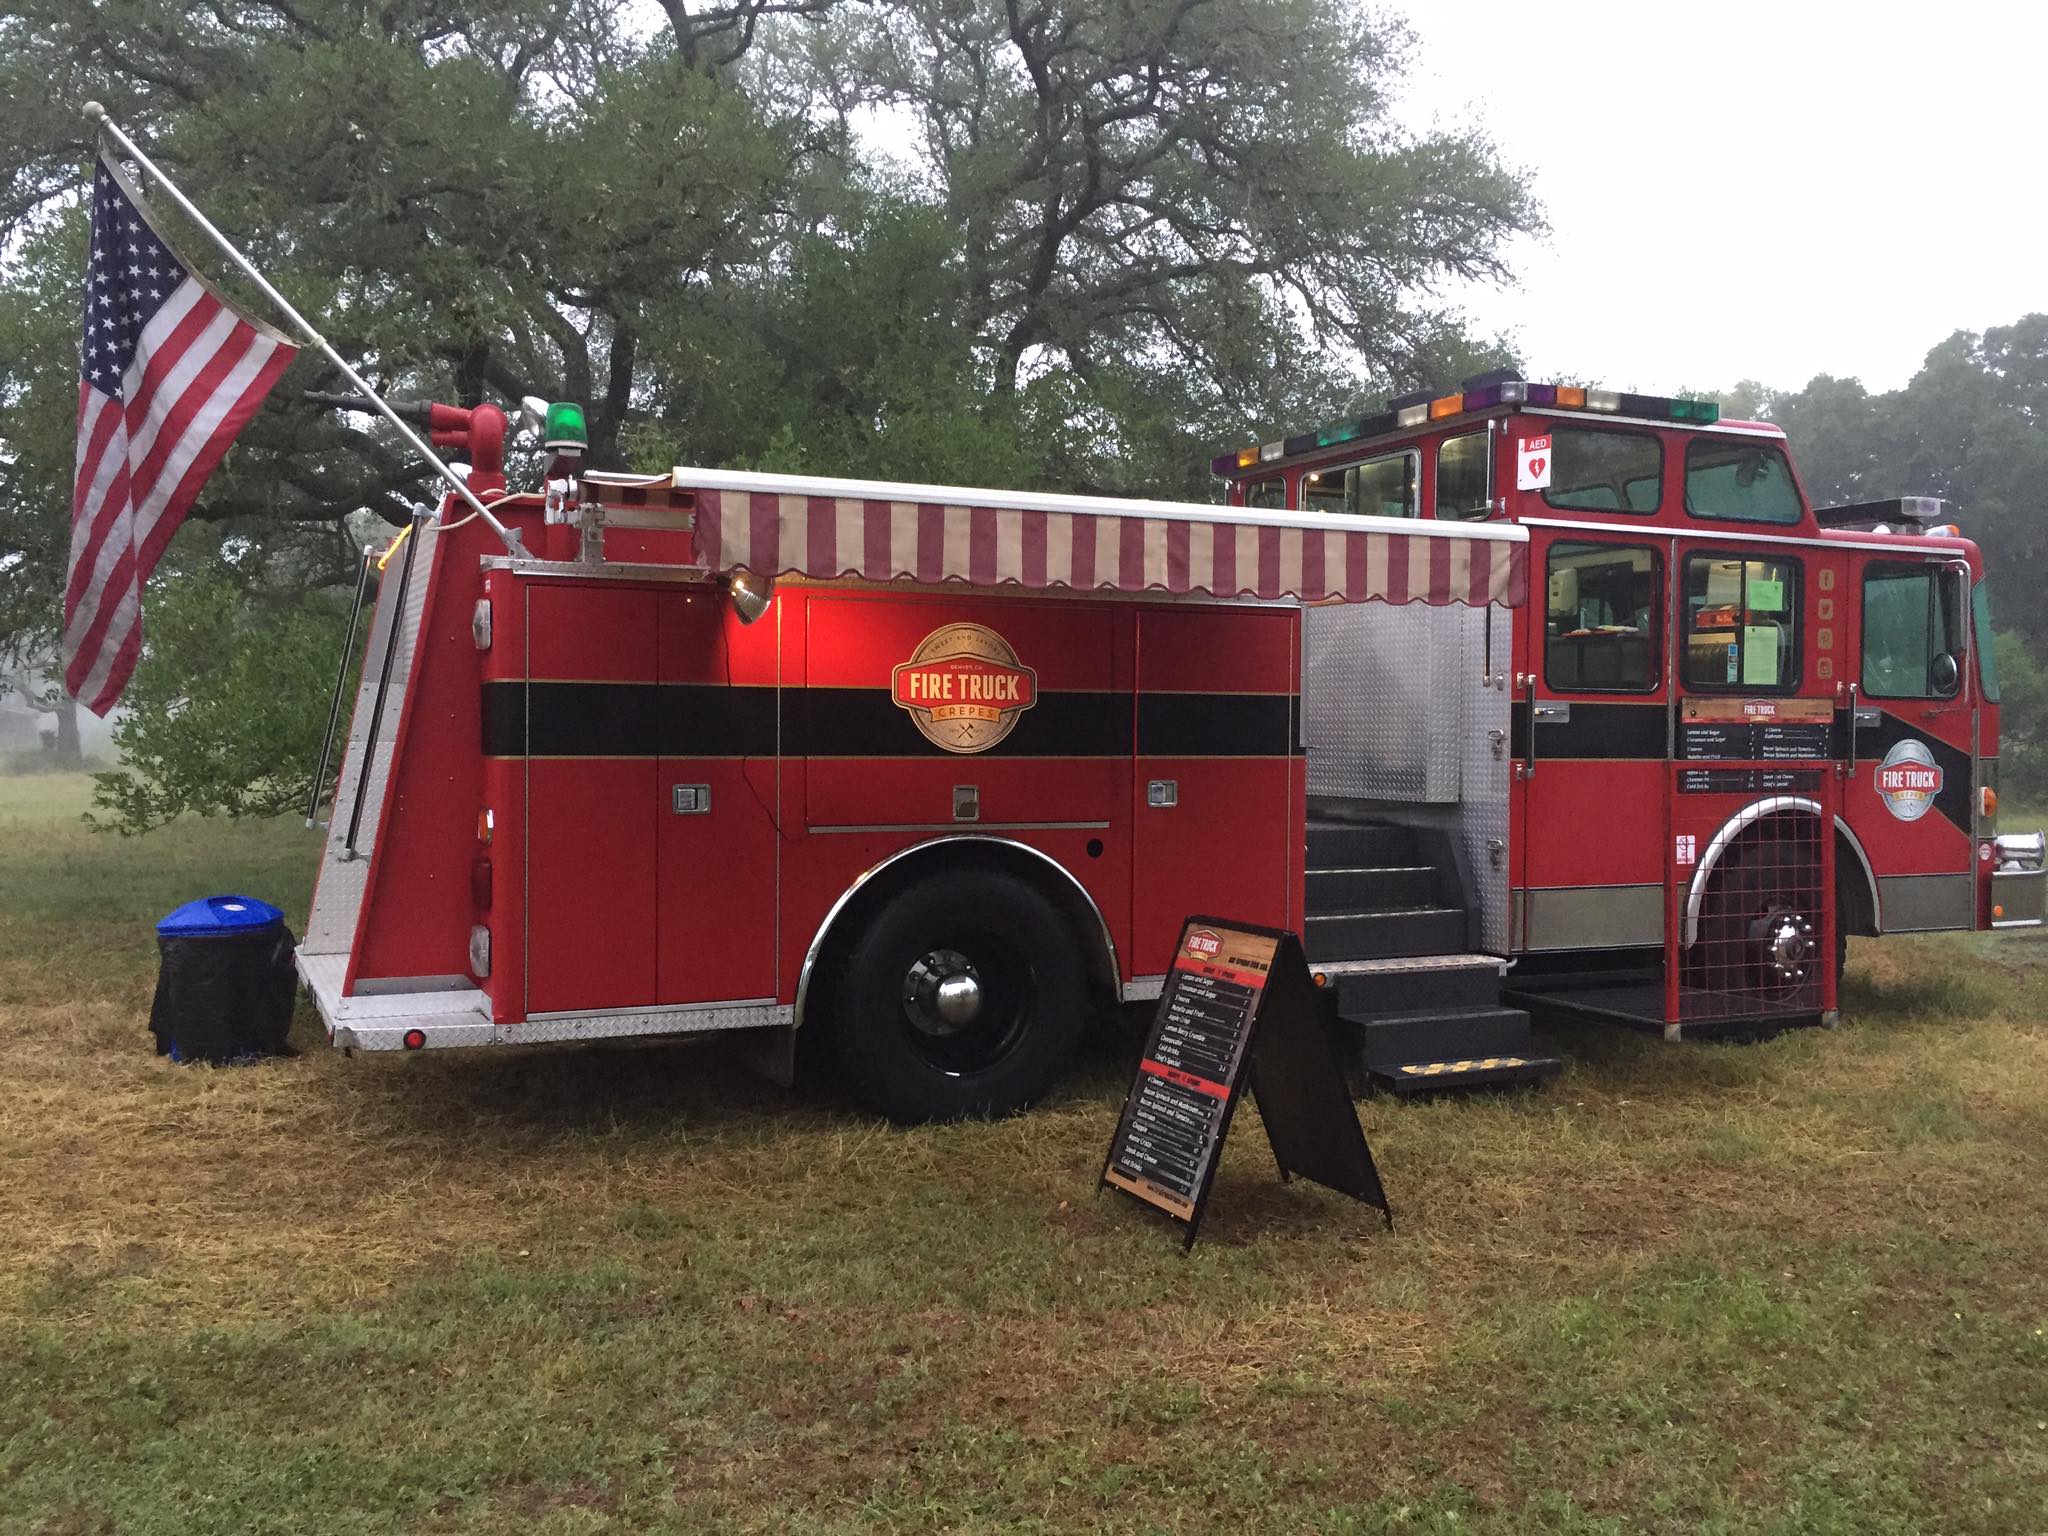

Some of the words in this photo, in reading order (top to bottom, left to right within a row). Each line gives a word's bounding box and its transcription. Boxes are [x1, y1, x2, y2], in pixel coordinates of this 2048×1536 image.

[1529, 438, 1547, 450] AED
[910, 673, 953, 699] FIRE
[958, 674, 1020, 700] TRUCK
[938, 706, 994, 718] CREPES
[1744, 705, 1756, 715] FIRE
[1757, 705, 1776, 715] TRUCK
[1882, 771, 1904, 788] FIRE
[1905, 771, 1935, 788] TRUCK
[1189, 936, 1202, 948] FIRE
[1201, 938, 1218, 952] TRUCK
[1203, 978, 1214, 986] Sugar
[1206, 990, 1217, 999] Sugar
[1194, 1010, 1204, 1018] Fruit
[1178, 1028, 1189, 1036] Berry
[1189, 1032, 1205, 1041] Crumble
[1159, 1043, 1167, 1051] Cold
[1168, 1047, 1180, 1055] Drinks
[1151, 1077, 1165, 1086] Cheese
[1136, 1150, 1144, 1158] and
[1144, 1154, 1158, 1164] Cheese
[1121, 1157, 1130, 1166] Cold
[1131, 1161, 1143, 1171] Drinks
